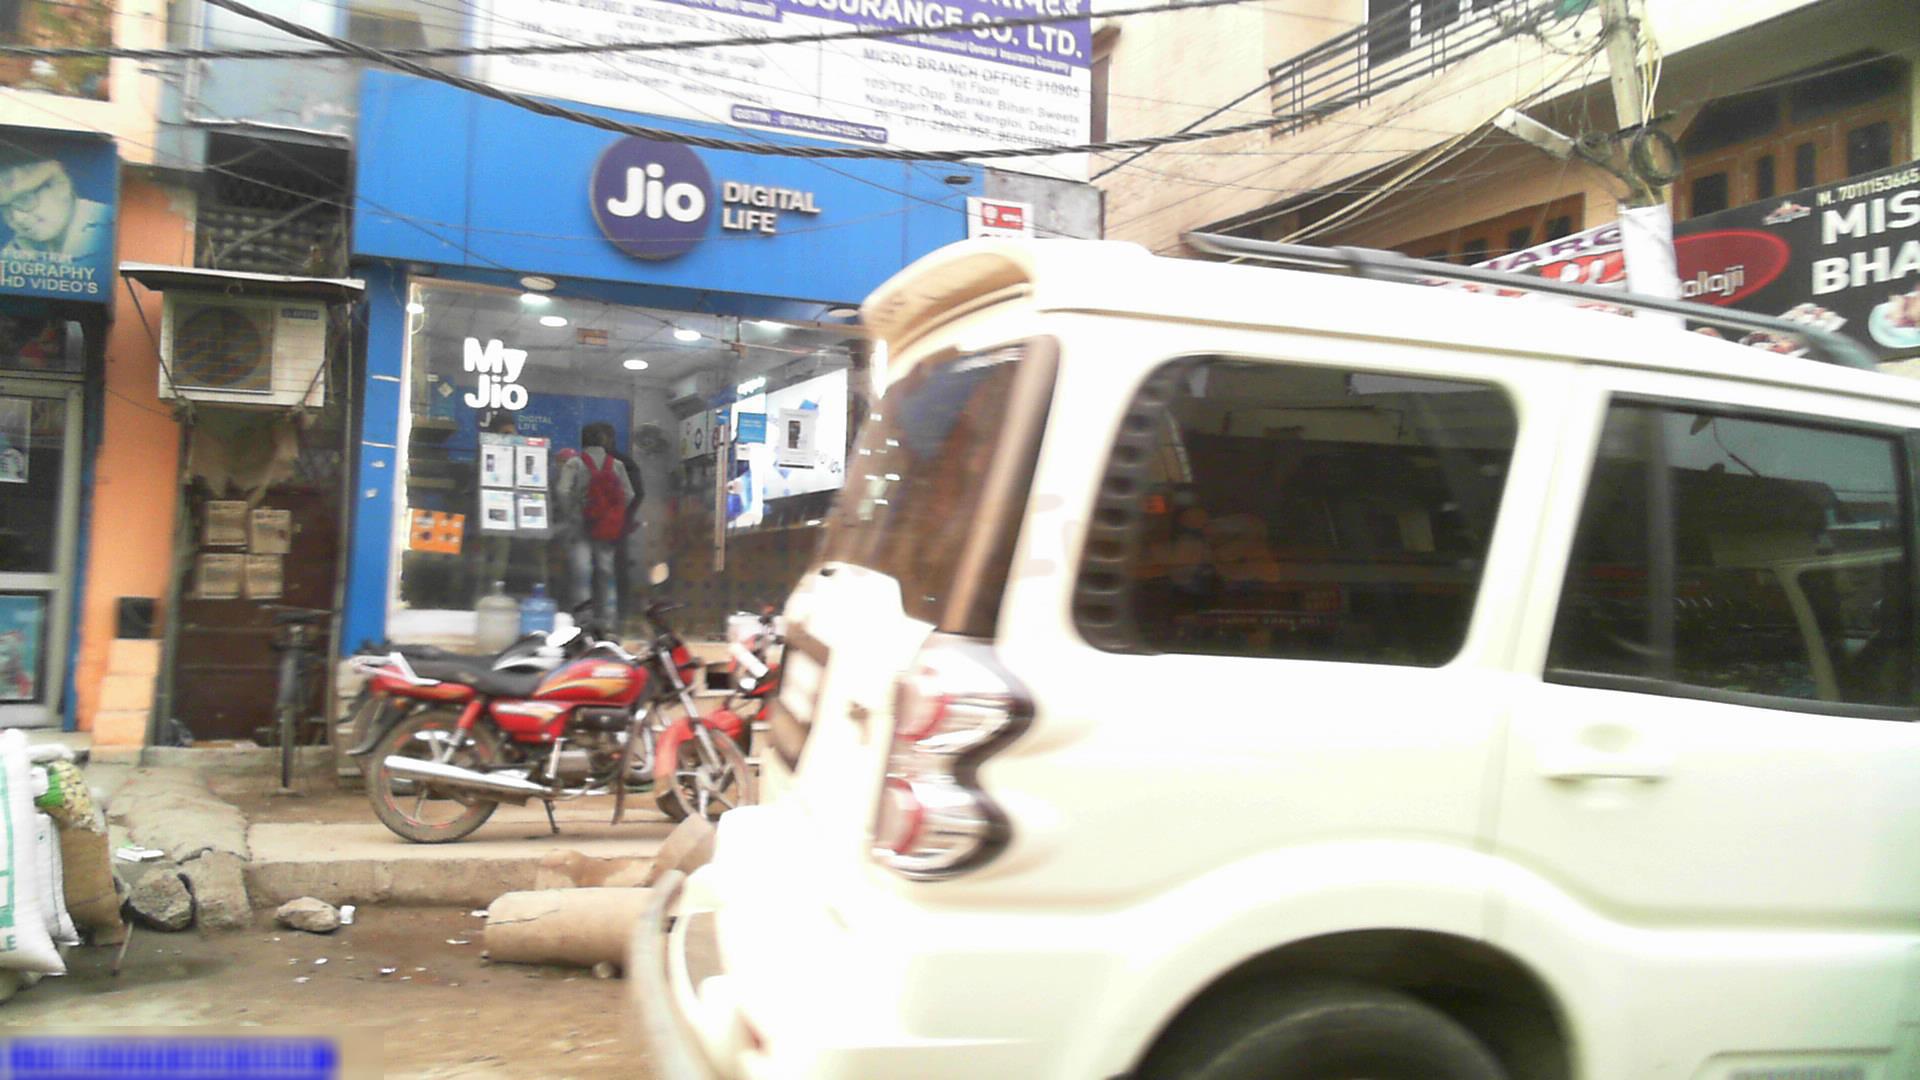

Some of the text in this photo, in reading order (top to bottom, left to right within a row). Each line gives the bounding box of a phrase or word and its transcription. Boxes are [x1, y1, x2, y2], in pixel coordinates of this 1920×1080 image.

[790, 0, 963, 31] URANCE
[971, 12, 1020, 46] CO.
[1026, 24, 1084, 59] LTD.
[864, 48, 912, 67] MICRO
[917, 56, 978, 78] BRANCH
[982, 68, 1033, 90] OFFICE
[607, 163, 706, 222] Jio
[723, 181, 821, 213] DIGITAL
[721, 208, 777, 234] LIFE
[31, 278, 99, 295] VIDEO'S
[1680, 264, 1745, 298] alaji
[464, 337, 528, 383] My
[464, 373, 529, 411] Jio
